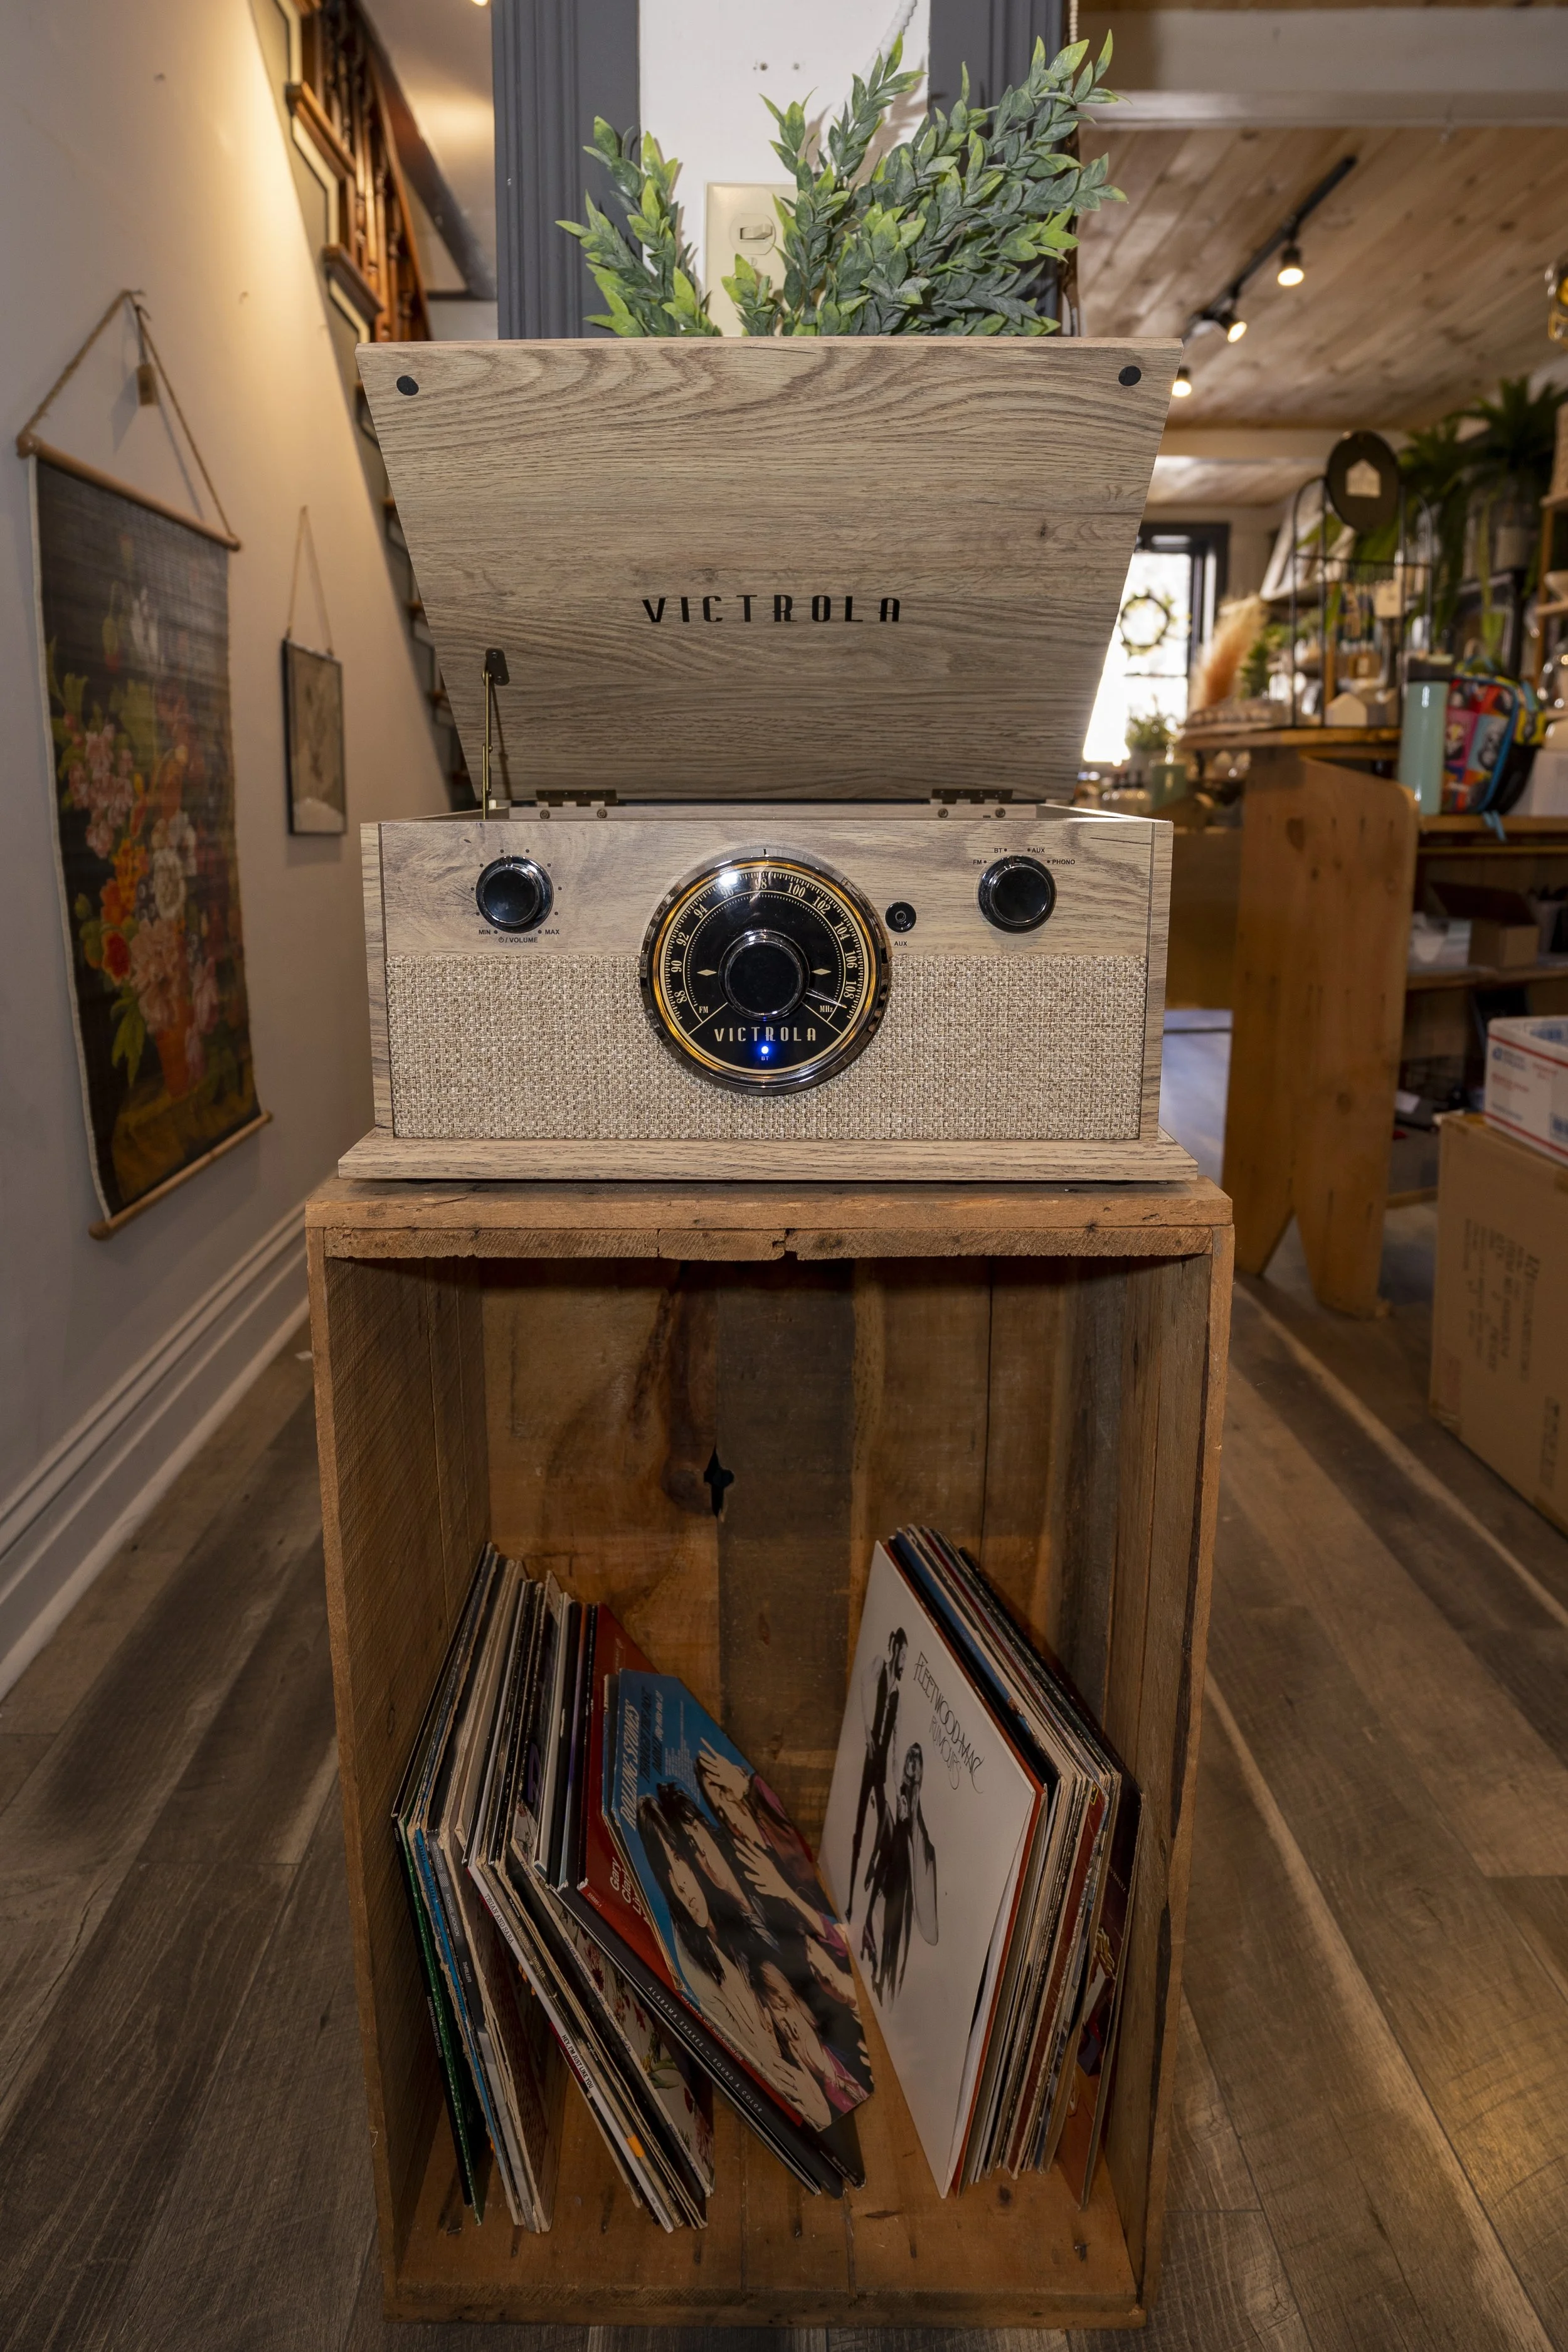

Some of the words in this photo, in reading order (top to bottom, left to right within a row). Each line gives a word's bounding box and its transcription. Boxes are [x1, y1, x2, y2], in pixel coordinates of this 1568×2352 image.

[642, 595, 901, 623] VICTROLA
[755, 878, 767, 890] 98
[788, 882, 806, 898] 100
[693, 904, 708, 919] 94
[812, 897, 831, 914] 102
[676, 932, 689, 946] 92
[834, 921, 850, 941] 104
[670, 960, 682, 973] 90
[844, 951, 857, 969] 106
[674, 990, 687, 1004] 88
[844, 980, 857, 999] 108
[820, 1005, 834, 1014] MHz
[714, 1027, 817, 1042] VICTROLA
[623, 1698, 640, 1764] STONES
[620, 1754, 638, 1831] ROLLING
[610, 1857, 622, 1891] Gary
[484, 1892, 499, 1914] TEGAN
[494, 1913, 506, 1928] AND
[501, 1926, 514, 1944] SARA
[444, 1892, 455, 1914] MICHAEL
[450, 1914, 461, 1937] JACKSON
[461, 1961, 472, 1983] THRILLER
[531, 1956, 546, 1978] THRILLER
[426, 1995, 435, 2016] ALABAMA
[647, 1985, 679, 2019] ALABAMA
[678, 2020, 704, 2048] SHAKES
[712, 2057, 734, 2082] SOUND
[740, 2089, 764, 2114] COLOR
[560, 2033, 571, 2047] HEY,
[567, 2045, 575, 2055] I'M
[571, 2053, 583, 2067] JUST
[578, 2065, 588, 2078] LIKE
[585, 2077, 594, 2089] YOU
